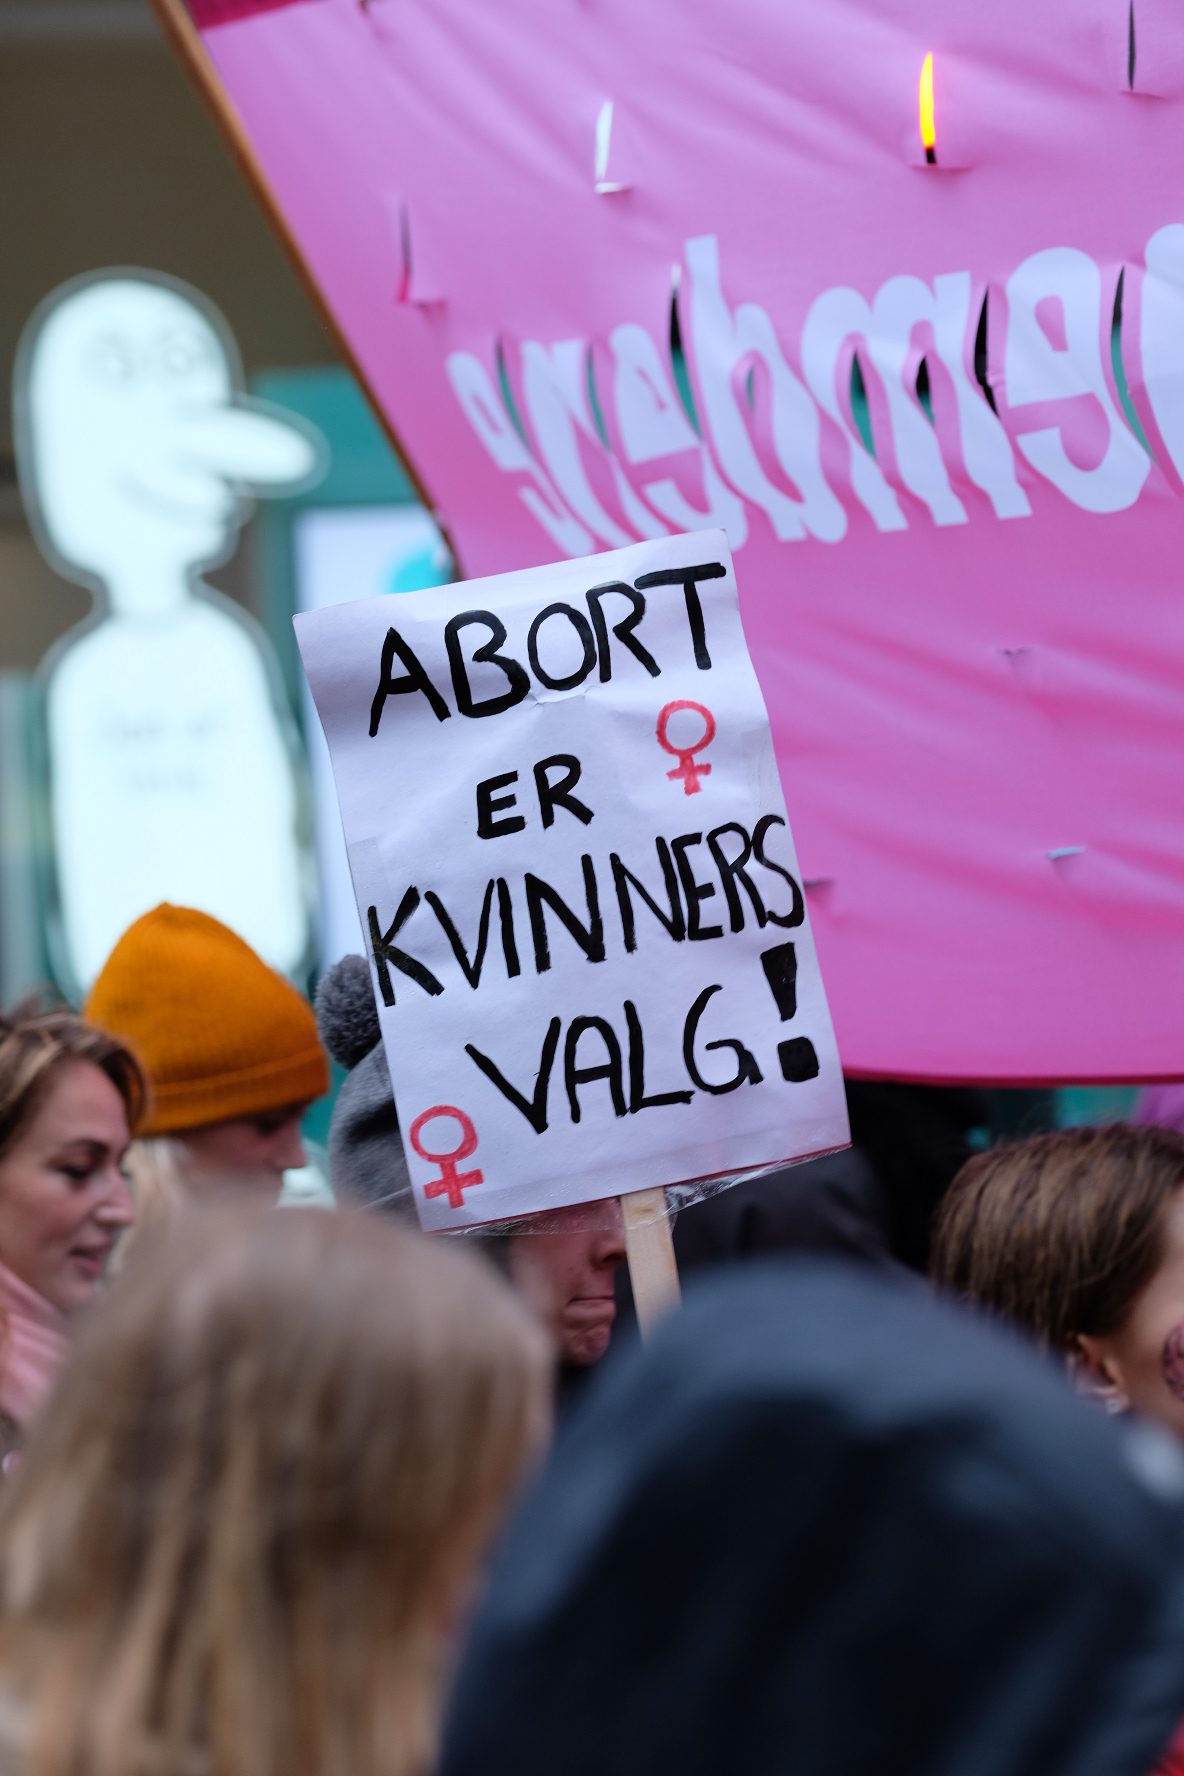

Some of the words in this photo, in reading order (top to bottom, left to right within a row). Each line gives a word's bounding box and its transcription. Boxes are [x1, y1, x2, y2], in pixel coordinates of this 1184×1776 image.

[369, 562, 727, 738] ABORT
[476, 754, 595, 840] ER
[368, 815, 804, 1007] KVINNERS
[465, 942, 820, 1135] VALG!
